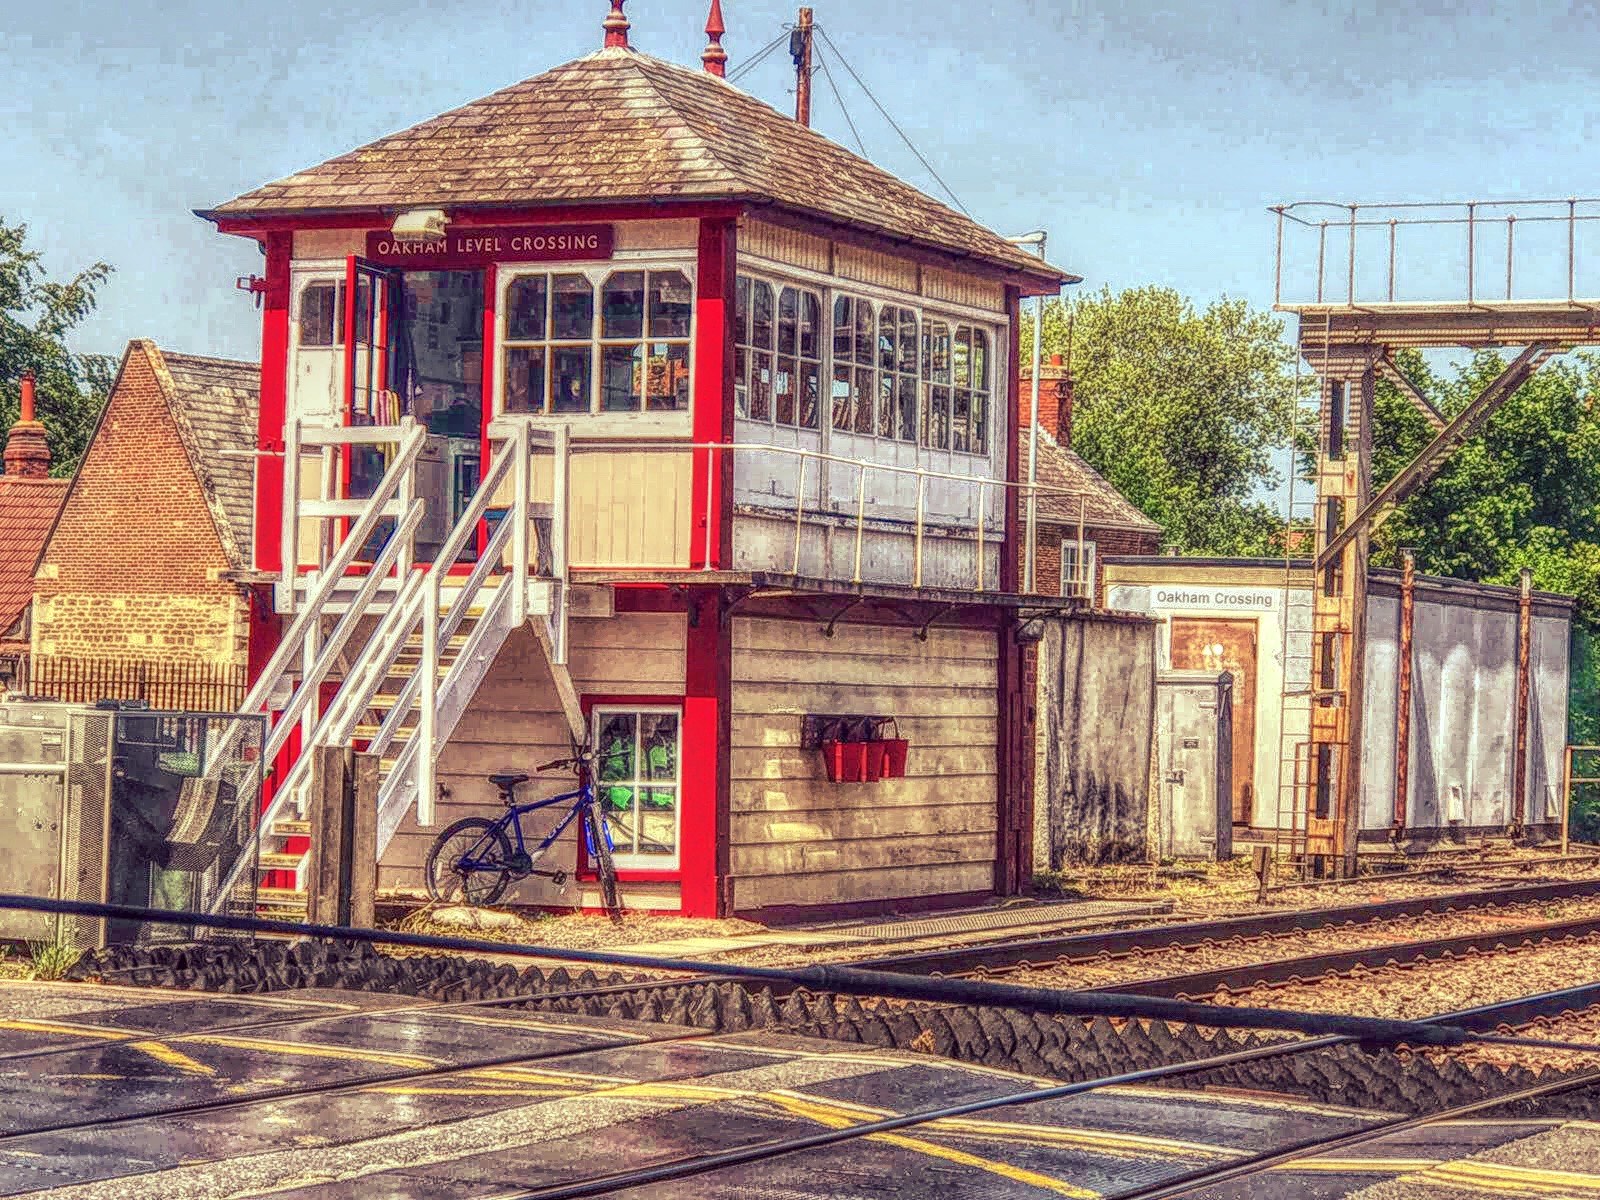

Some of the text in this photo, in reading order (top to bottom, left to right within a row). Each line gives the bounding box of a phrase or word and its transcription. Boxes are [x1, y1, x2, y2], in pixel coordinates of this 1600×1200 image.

[378, 235, 598, 255] OAKHAM LEVEL CROSSING
[1157, 590, 1272, 607] Oakham Crossing
